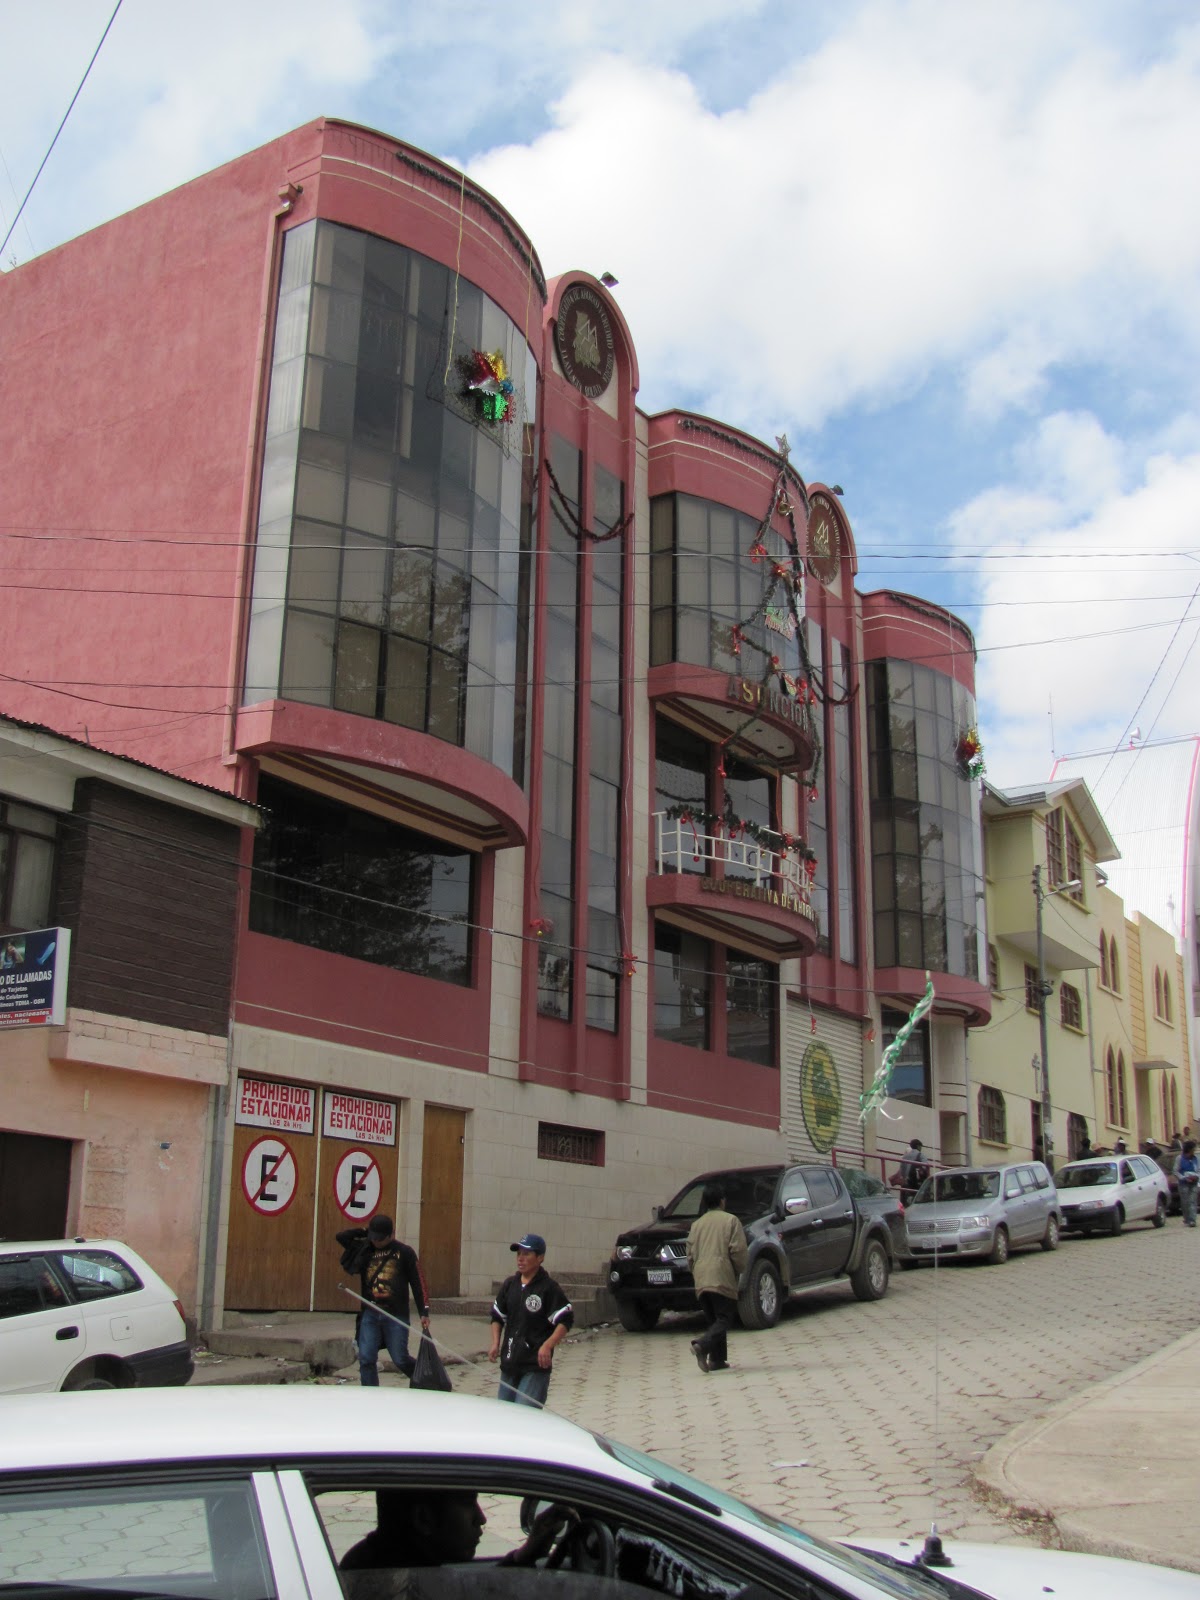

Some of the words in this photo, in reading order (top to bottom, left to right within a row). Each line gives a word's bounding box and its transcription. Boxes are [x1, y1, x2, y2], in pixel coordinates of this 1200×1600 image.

[6, 975, 15, 984] DE
[16, 970, 52, 983] LLAMADAS
[243, 1080, 310, 1106] PROHIBIDO
[241, 1097, 311, 1123] ESTACIONAR
[332, 1095, 391, 1120] PROHIBIDO
[269, 1118, 280, 1126] LAS
[330, 1112, 393, 1136] ESTACIONAR
